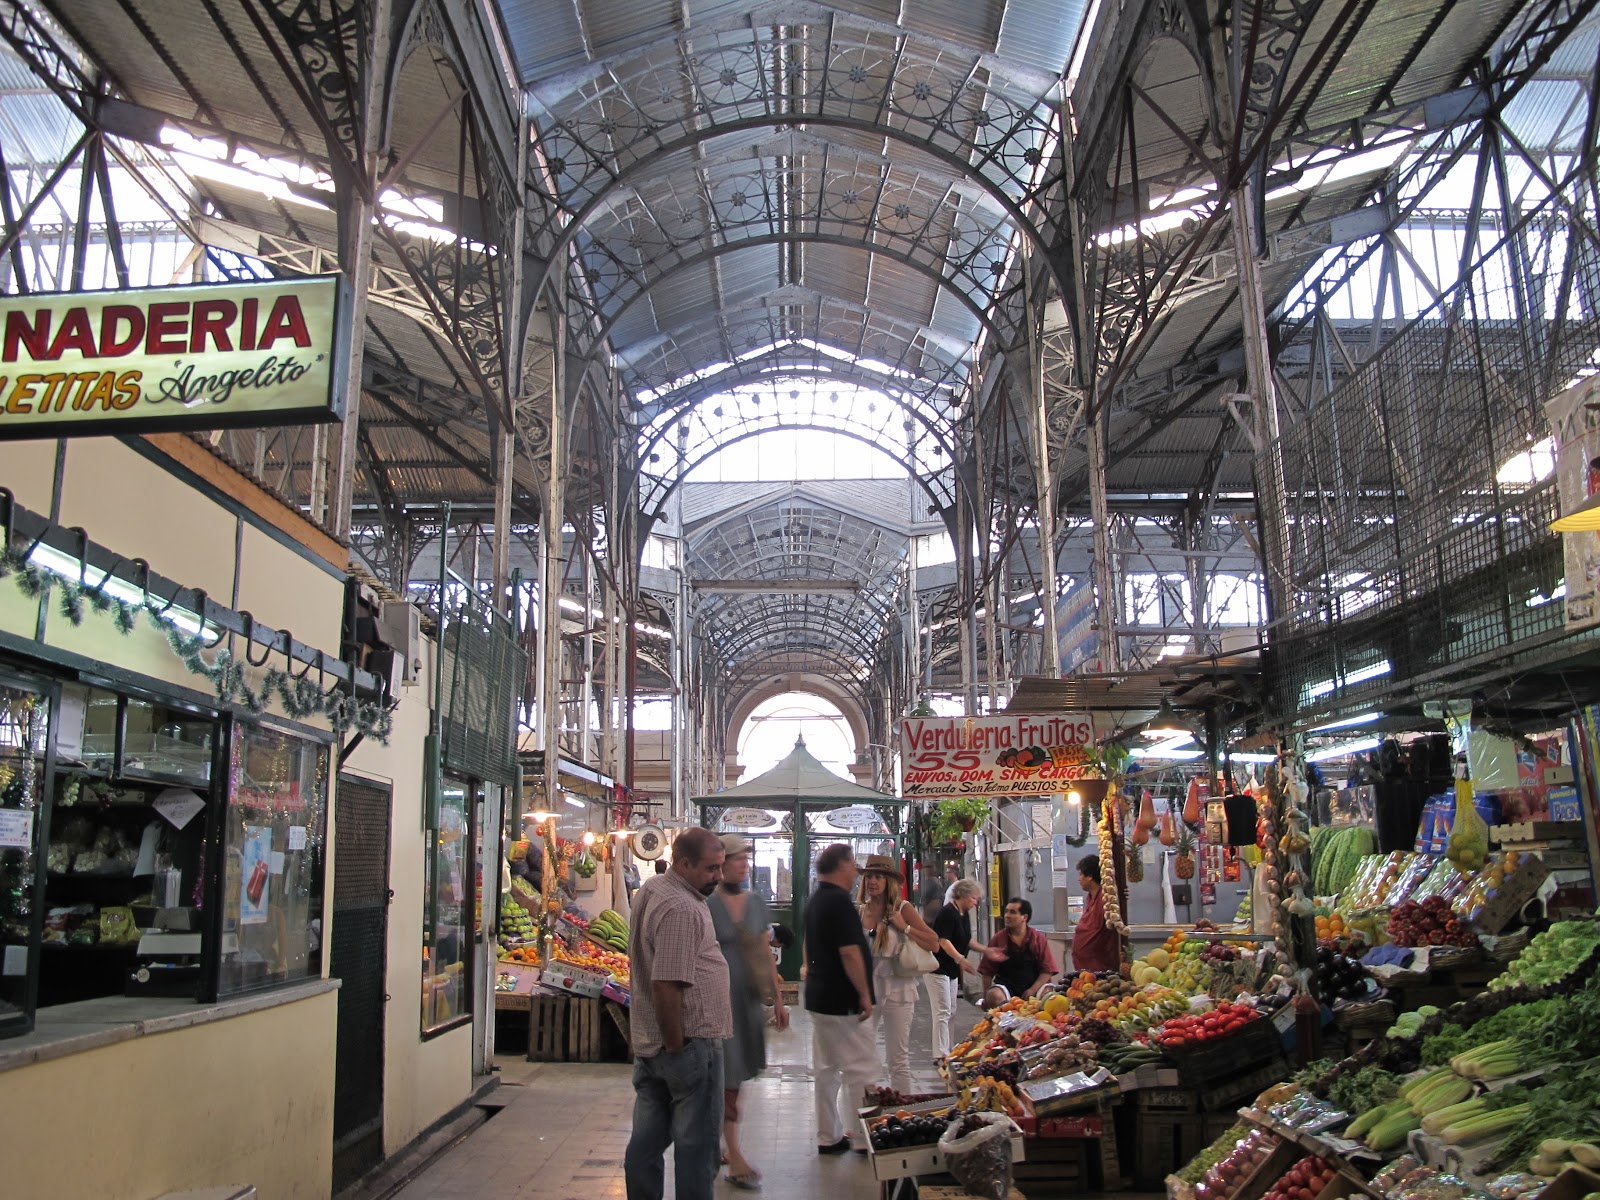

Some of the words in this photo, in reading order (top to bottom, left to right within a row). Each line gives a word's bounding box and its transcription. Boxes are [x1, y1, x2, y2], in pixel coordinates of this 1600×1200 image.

[2, 295, 312, 362] NADERIA
[904, 771, 953, 783] ENVIOS
[958, 769, 994, 782] DOM.
[999, 768, 1031, 780] SIN
[1038, 765, 1087, 779] CARGO
[904, 783, 957, 794] Mercado
[958, 781, 984, 793] San
[984, 781, 1010, 792] Telmo
[1010, 781, 1058, 791] PUESTOS
